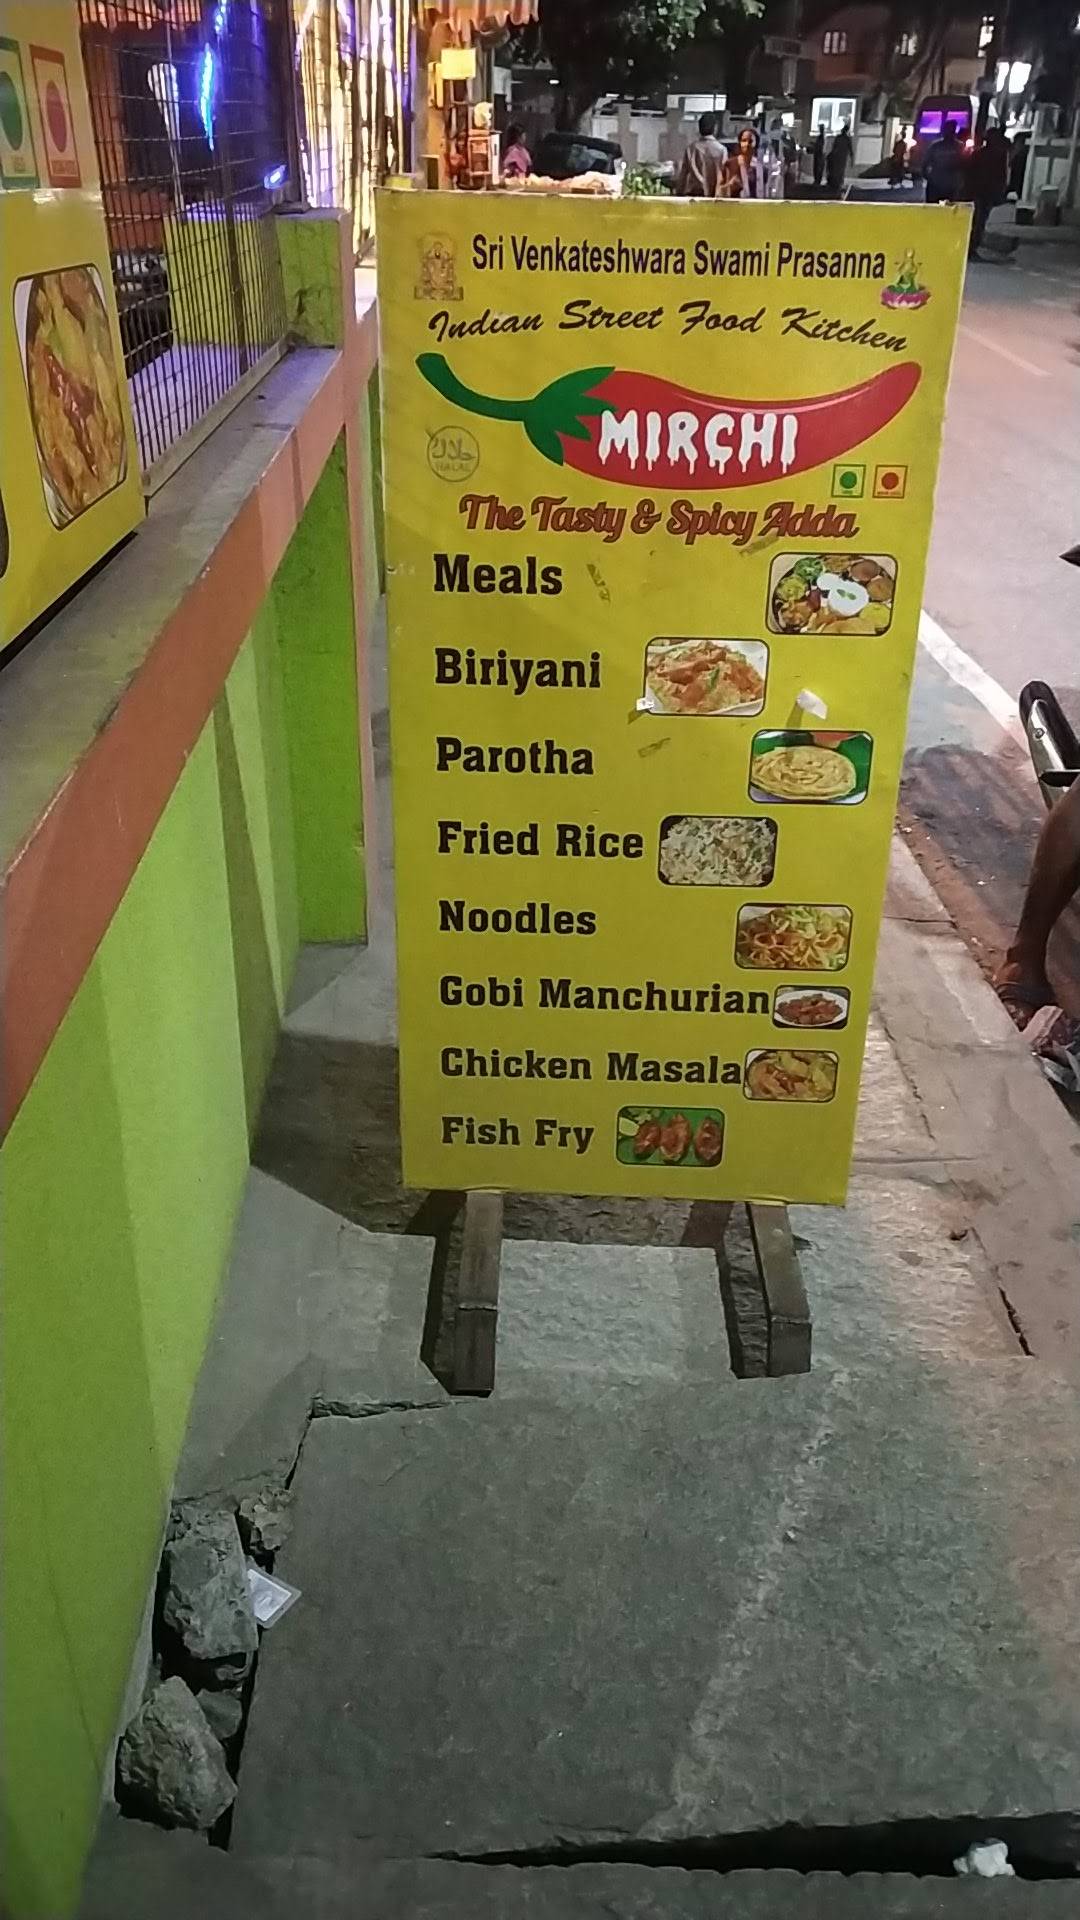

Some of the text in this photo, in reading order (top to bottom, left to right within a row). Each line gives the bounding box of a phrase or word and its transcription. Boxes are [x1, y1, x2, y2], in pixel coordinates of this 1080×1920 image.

[472, 233, 886, 278] Sri Venkateshwara Swami Prasanna
[428, 300, 908, 352] Indian Street Food Kitchen
[598, 409, 798, 475] MIRCHI
[459, 494, 860, 546] The Tasty & Spicy Adda
[433, 553, 563, 595] Meals
[435, 647, 602, 695] Biriyani
[436, 737, 594, 775] Parotha
[438, 821, 643, 858] Fried Rice
[439, 901, 597, 935] Noodles
[440, 976, 771, 1015] Gobi Manchurian
[441, 1048, 741, 1085] Chicken Masala
[442, 1117, 594, 1154] Fish Fry
